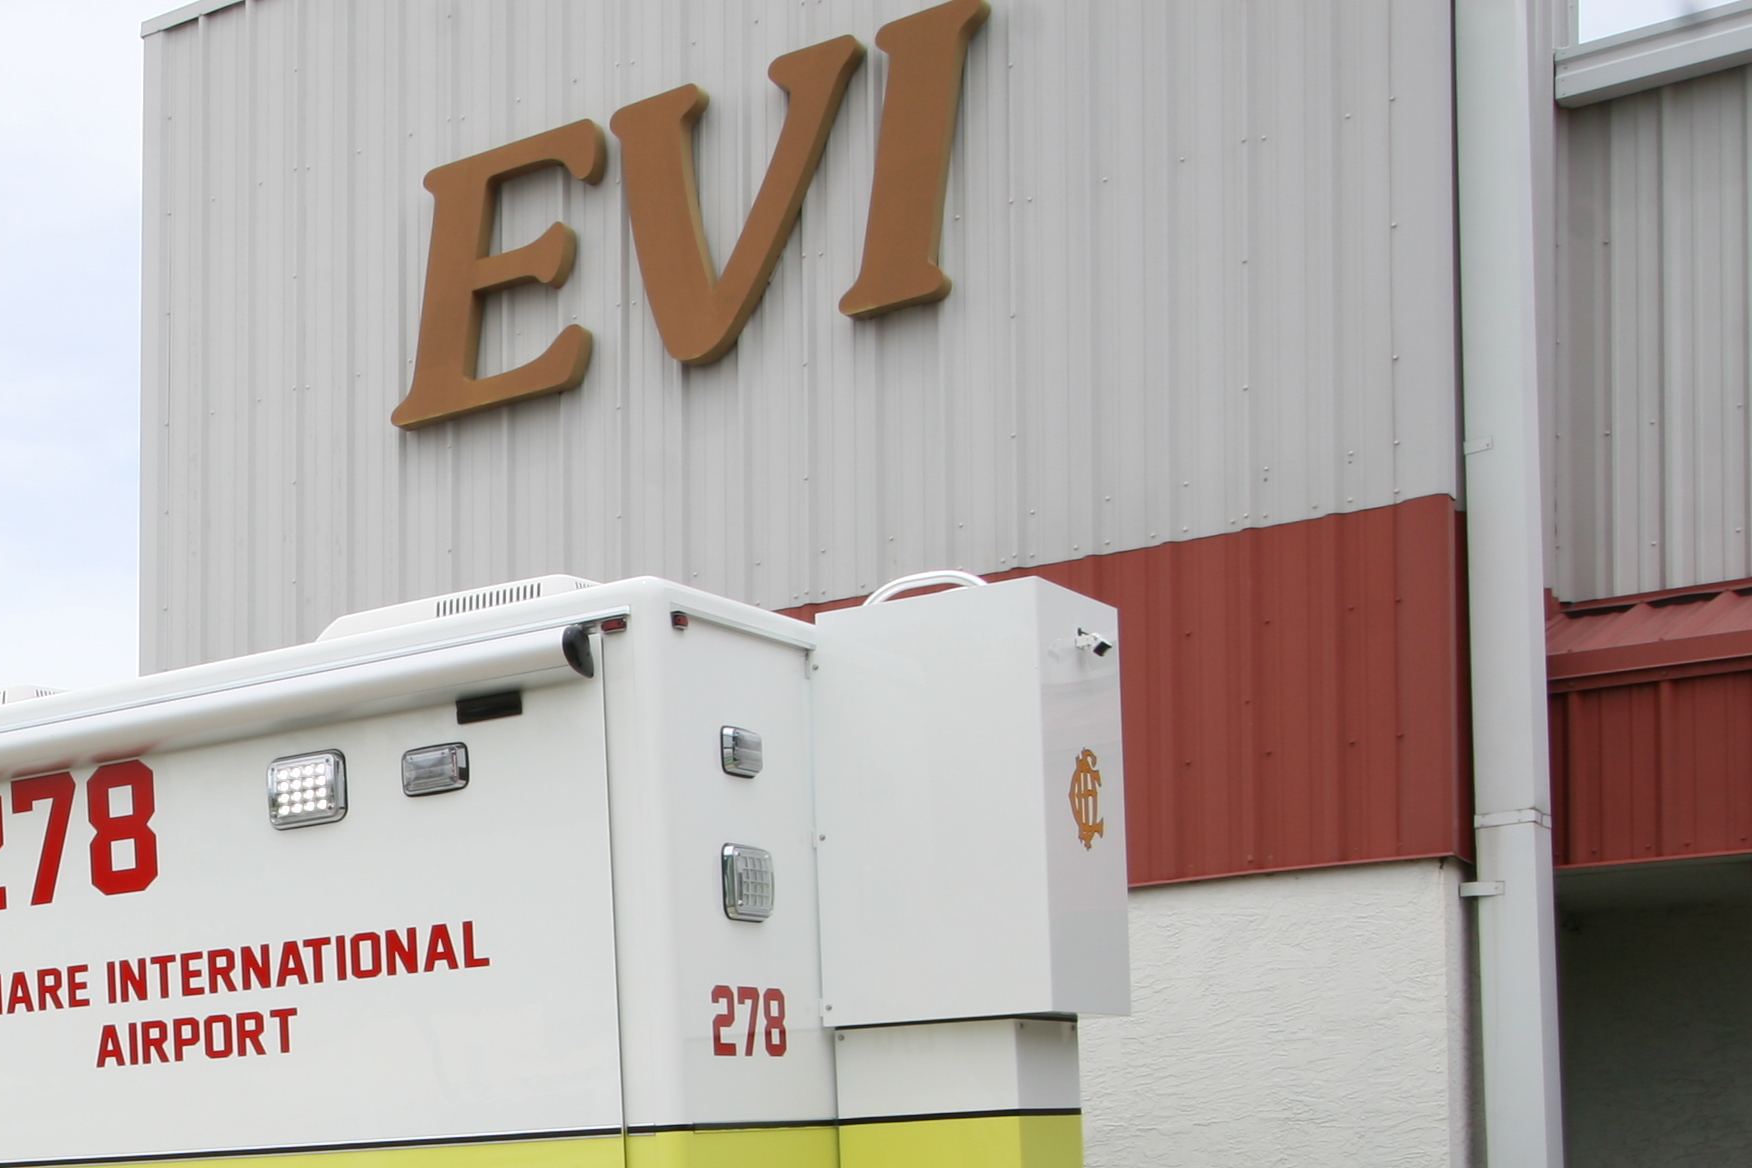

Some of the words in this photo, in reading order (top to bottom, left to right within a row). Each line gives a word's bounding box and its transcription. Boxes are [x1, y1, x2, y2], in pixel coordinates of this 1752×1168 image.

[391, 0, 992, 431] EVI
[107, 921, 491, 1004] INTERNATIONAL
[96, 1007, 298, 1069] AIRPORT
[711, 985, 787, 1057] 278
